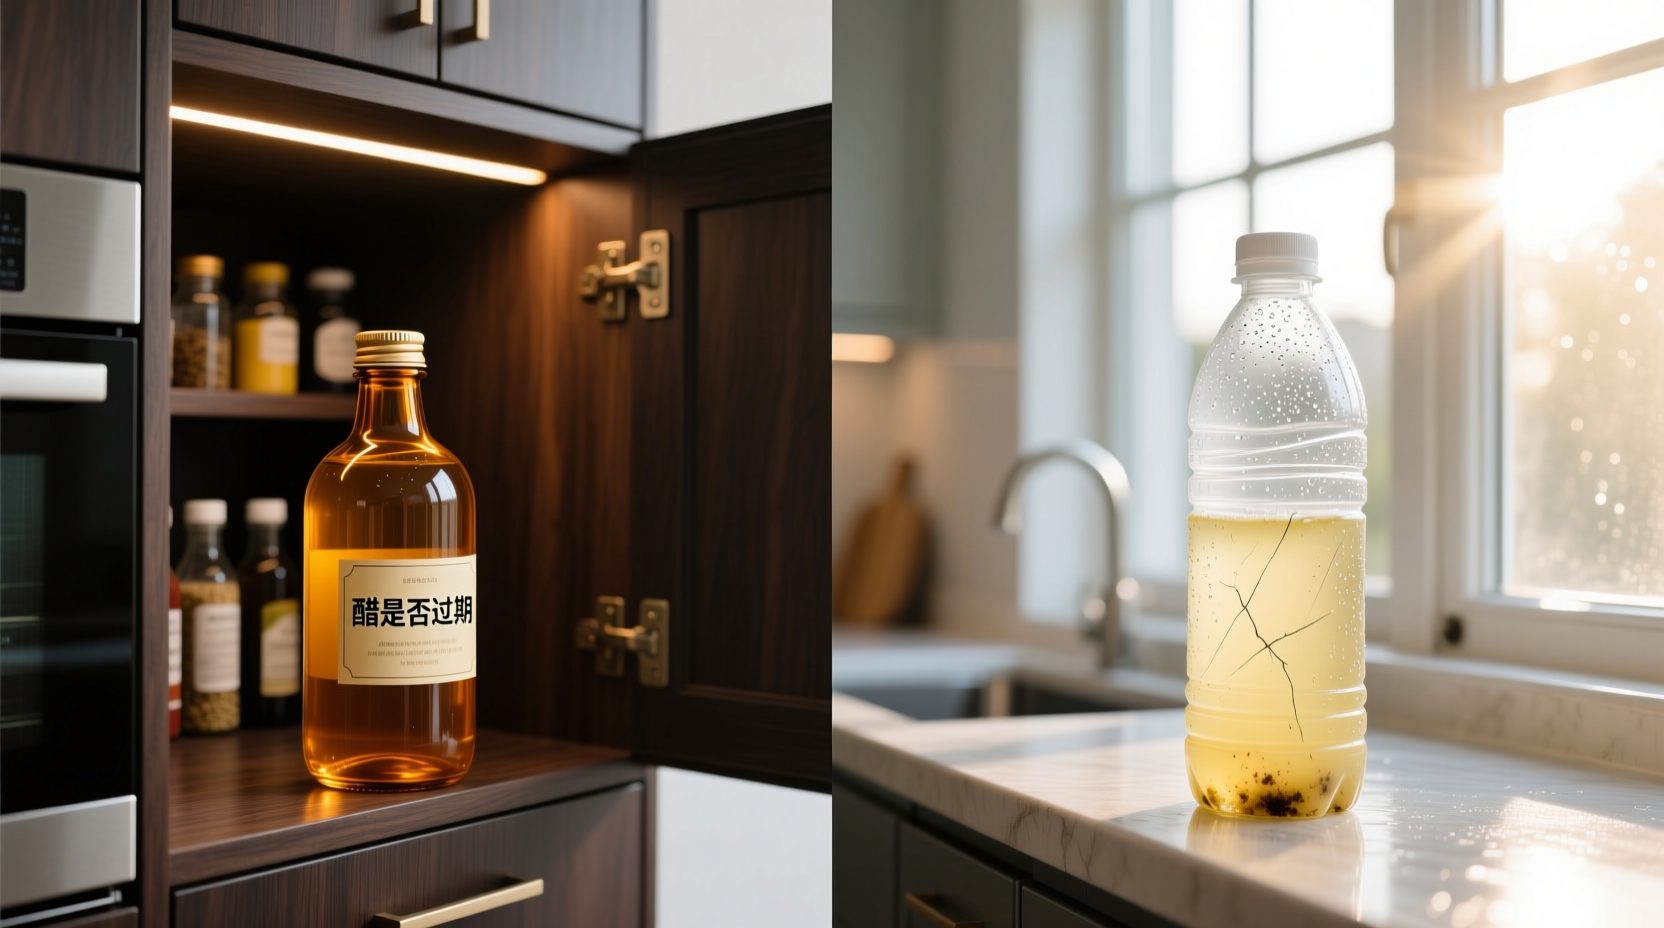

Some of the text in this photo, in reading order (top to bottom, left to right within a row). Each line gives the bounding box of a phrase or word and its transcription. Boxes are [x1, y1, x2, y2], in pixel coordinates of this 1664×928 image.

[352, 595, 473, 627] 醋是否过期
